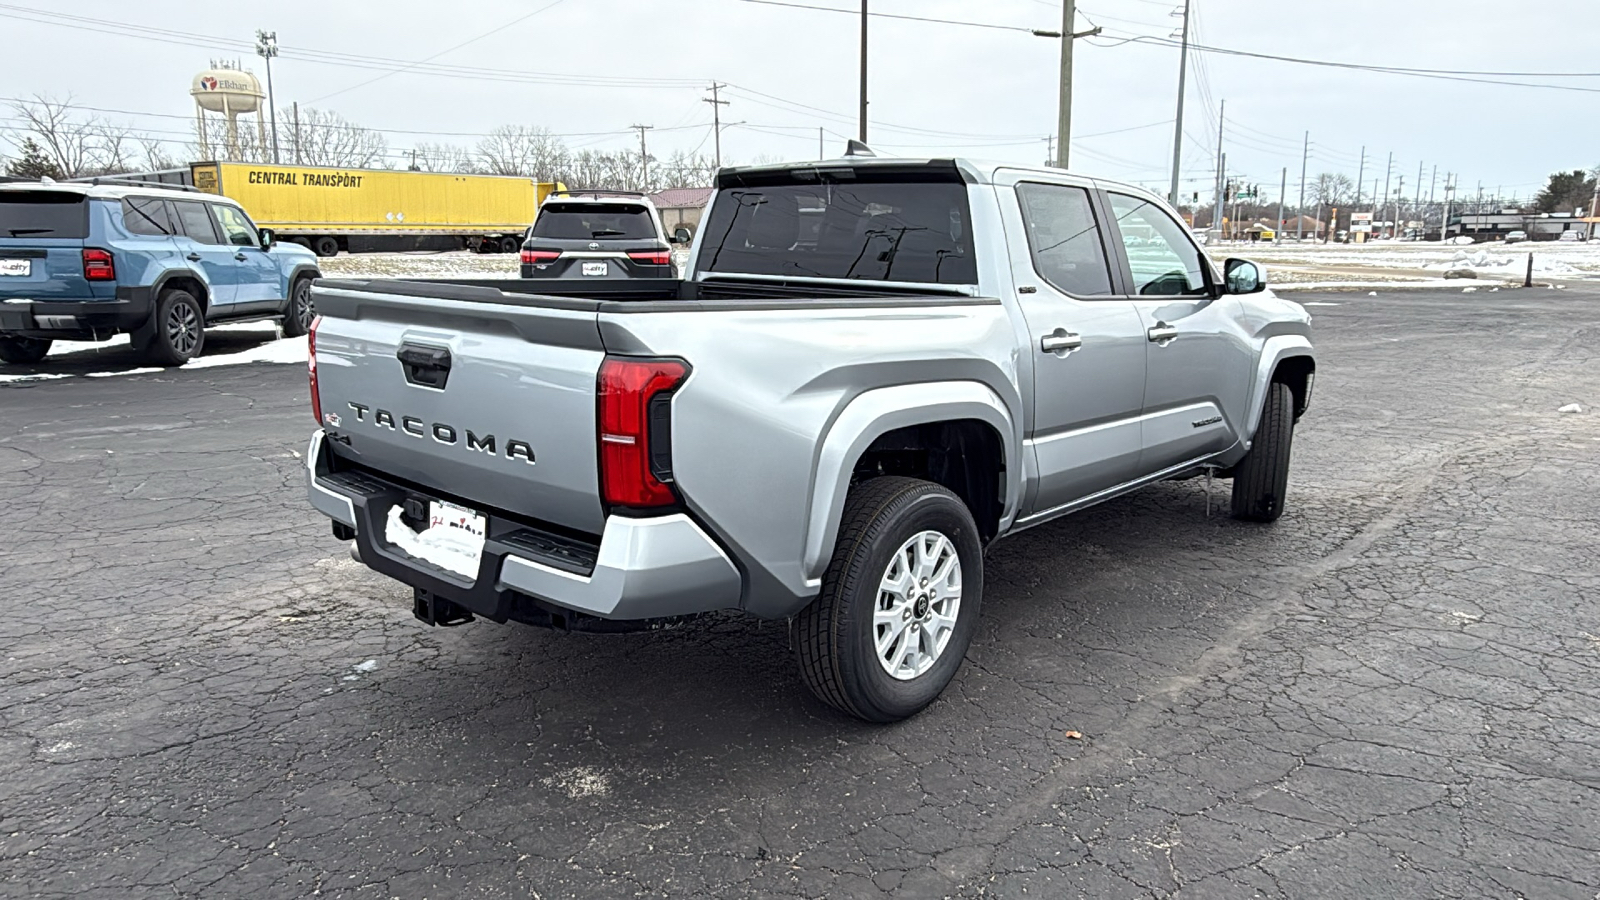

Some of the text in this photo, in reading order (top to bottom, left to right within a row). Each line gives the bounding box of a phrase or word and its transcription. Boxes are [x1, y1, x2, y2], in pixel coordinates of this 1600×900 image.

[249, 171, 362, 188] CENTRAL TRANSPORT
[348, 401, 536, 466] TACOMA
